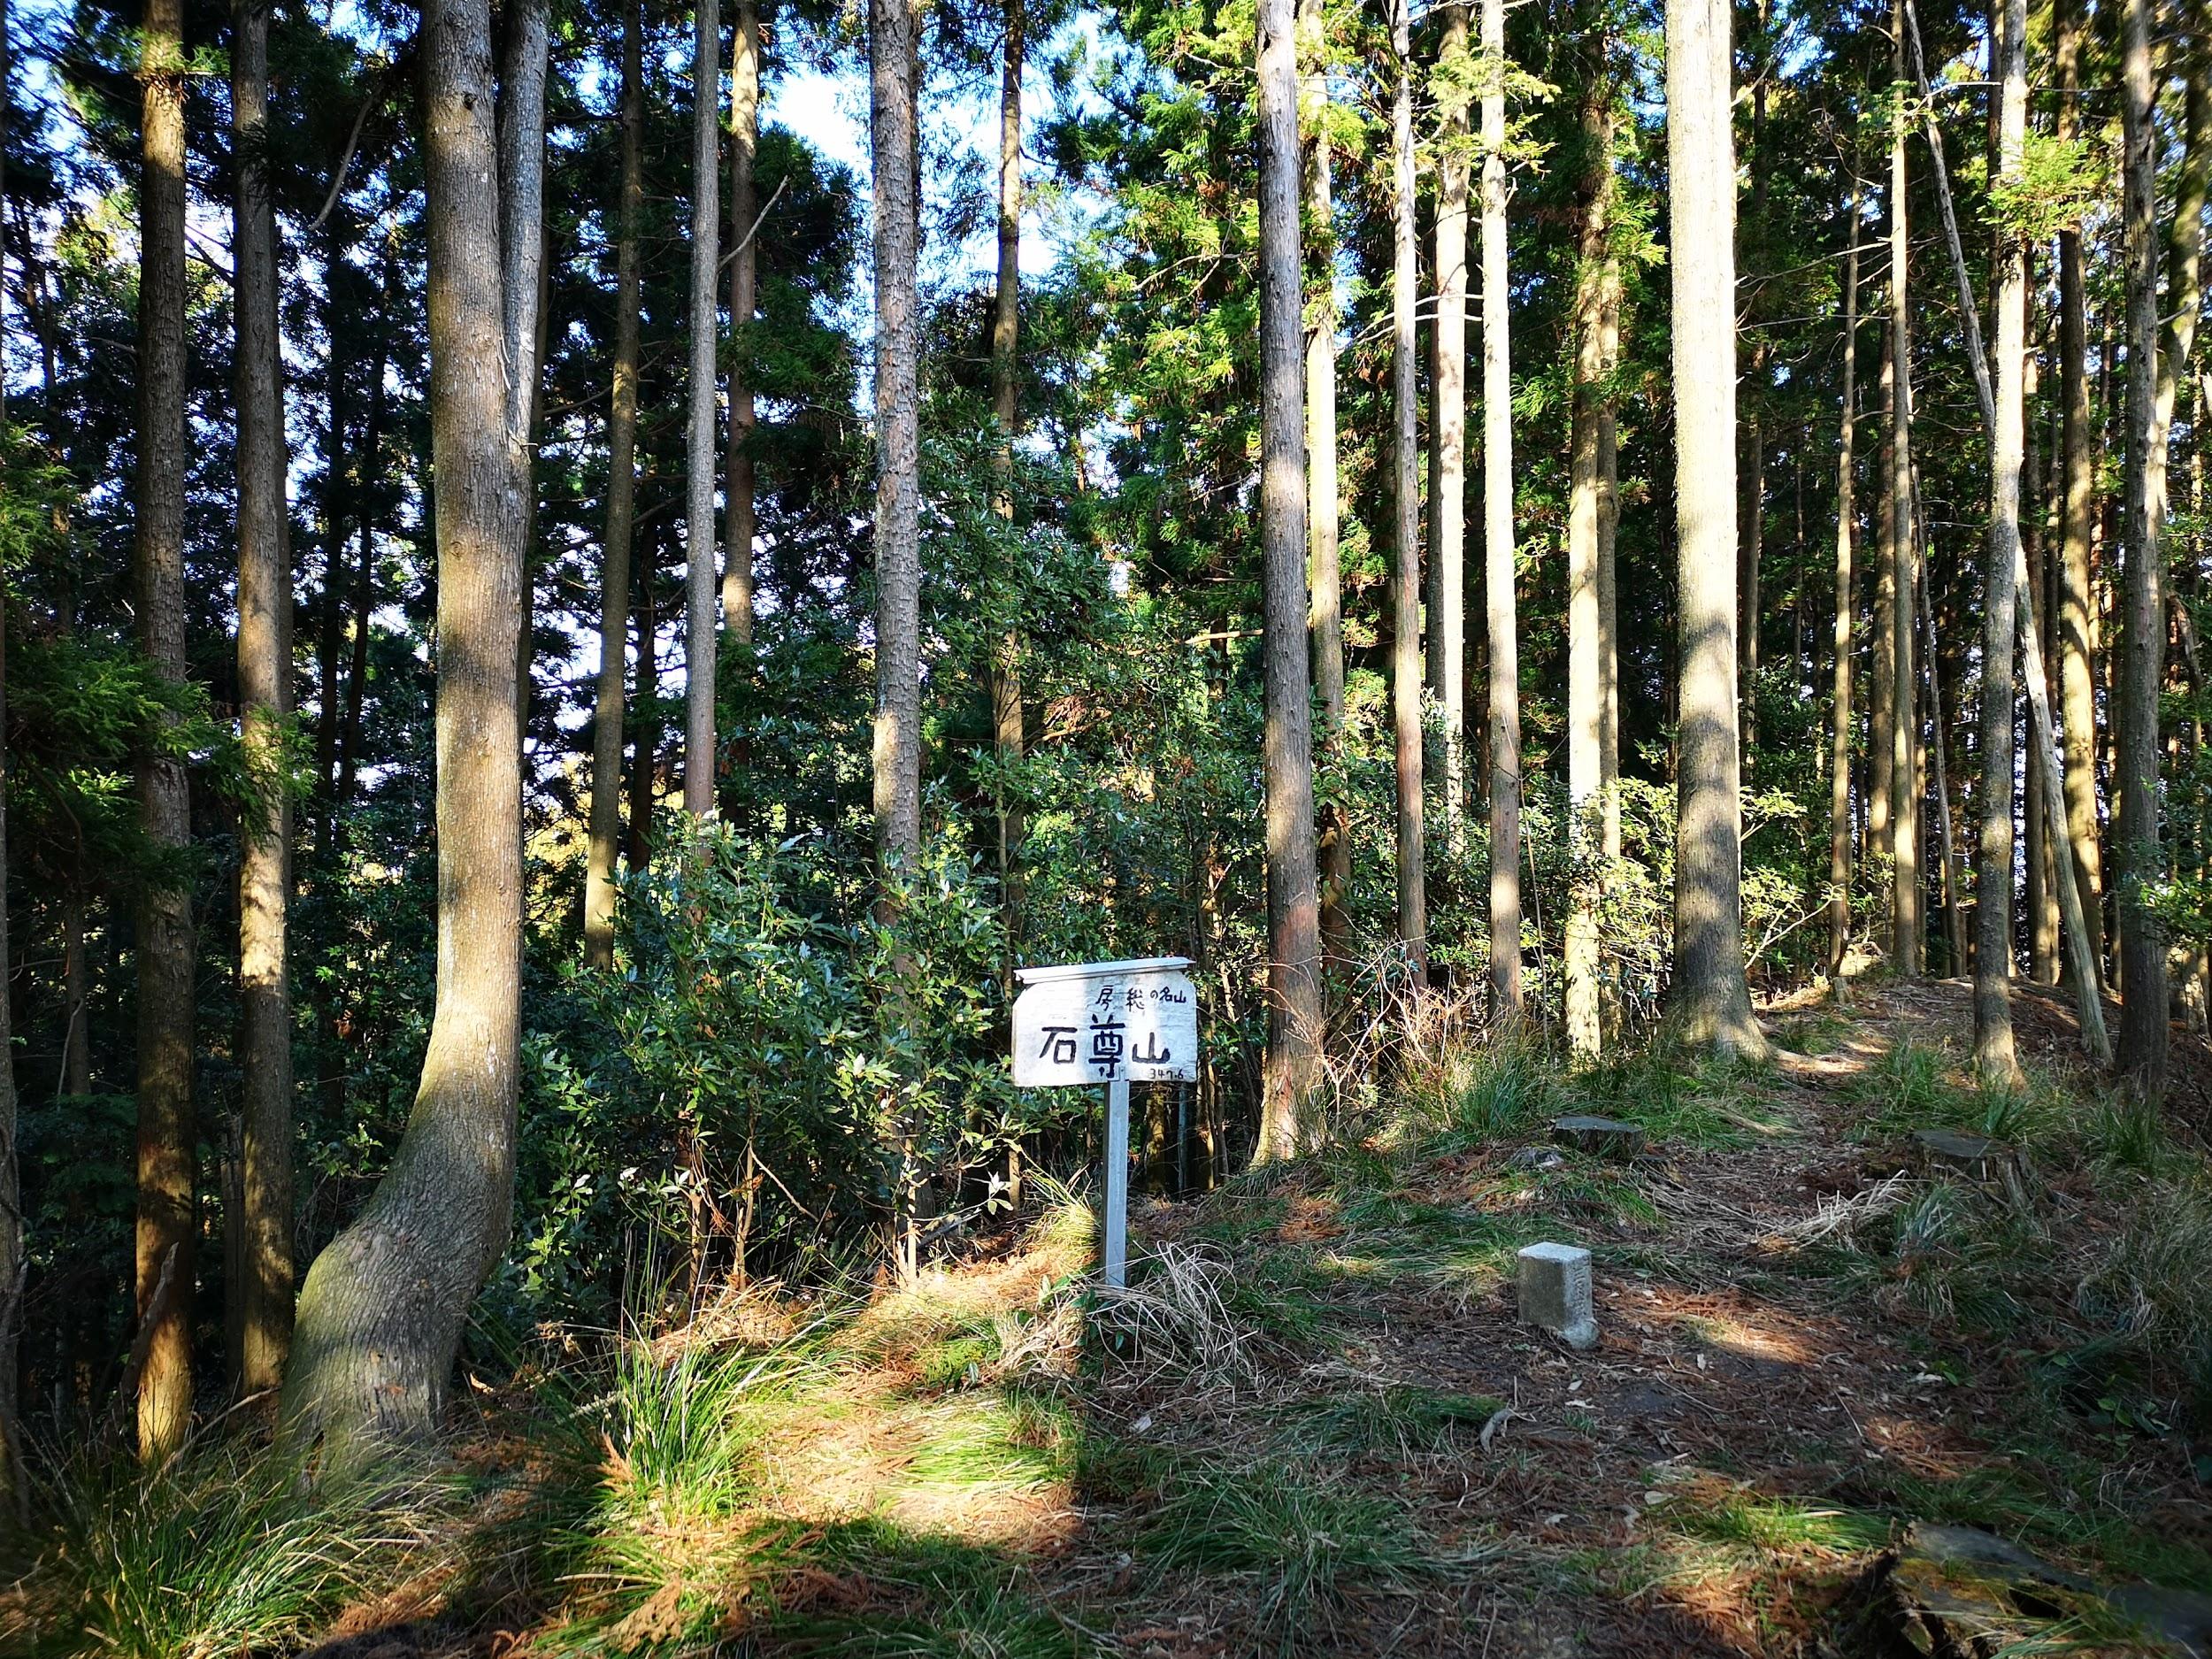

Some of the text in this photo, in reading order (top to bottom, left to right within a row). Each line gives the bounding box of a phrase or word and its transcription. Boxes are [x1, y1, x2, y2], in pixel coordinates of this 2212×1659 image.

[1095, 985, 1187, 1012] 房総の名山
[1039, 1014, 1171, 1079] 石尊山
[1149, 1068, 1184, 1079] 347.6
